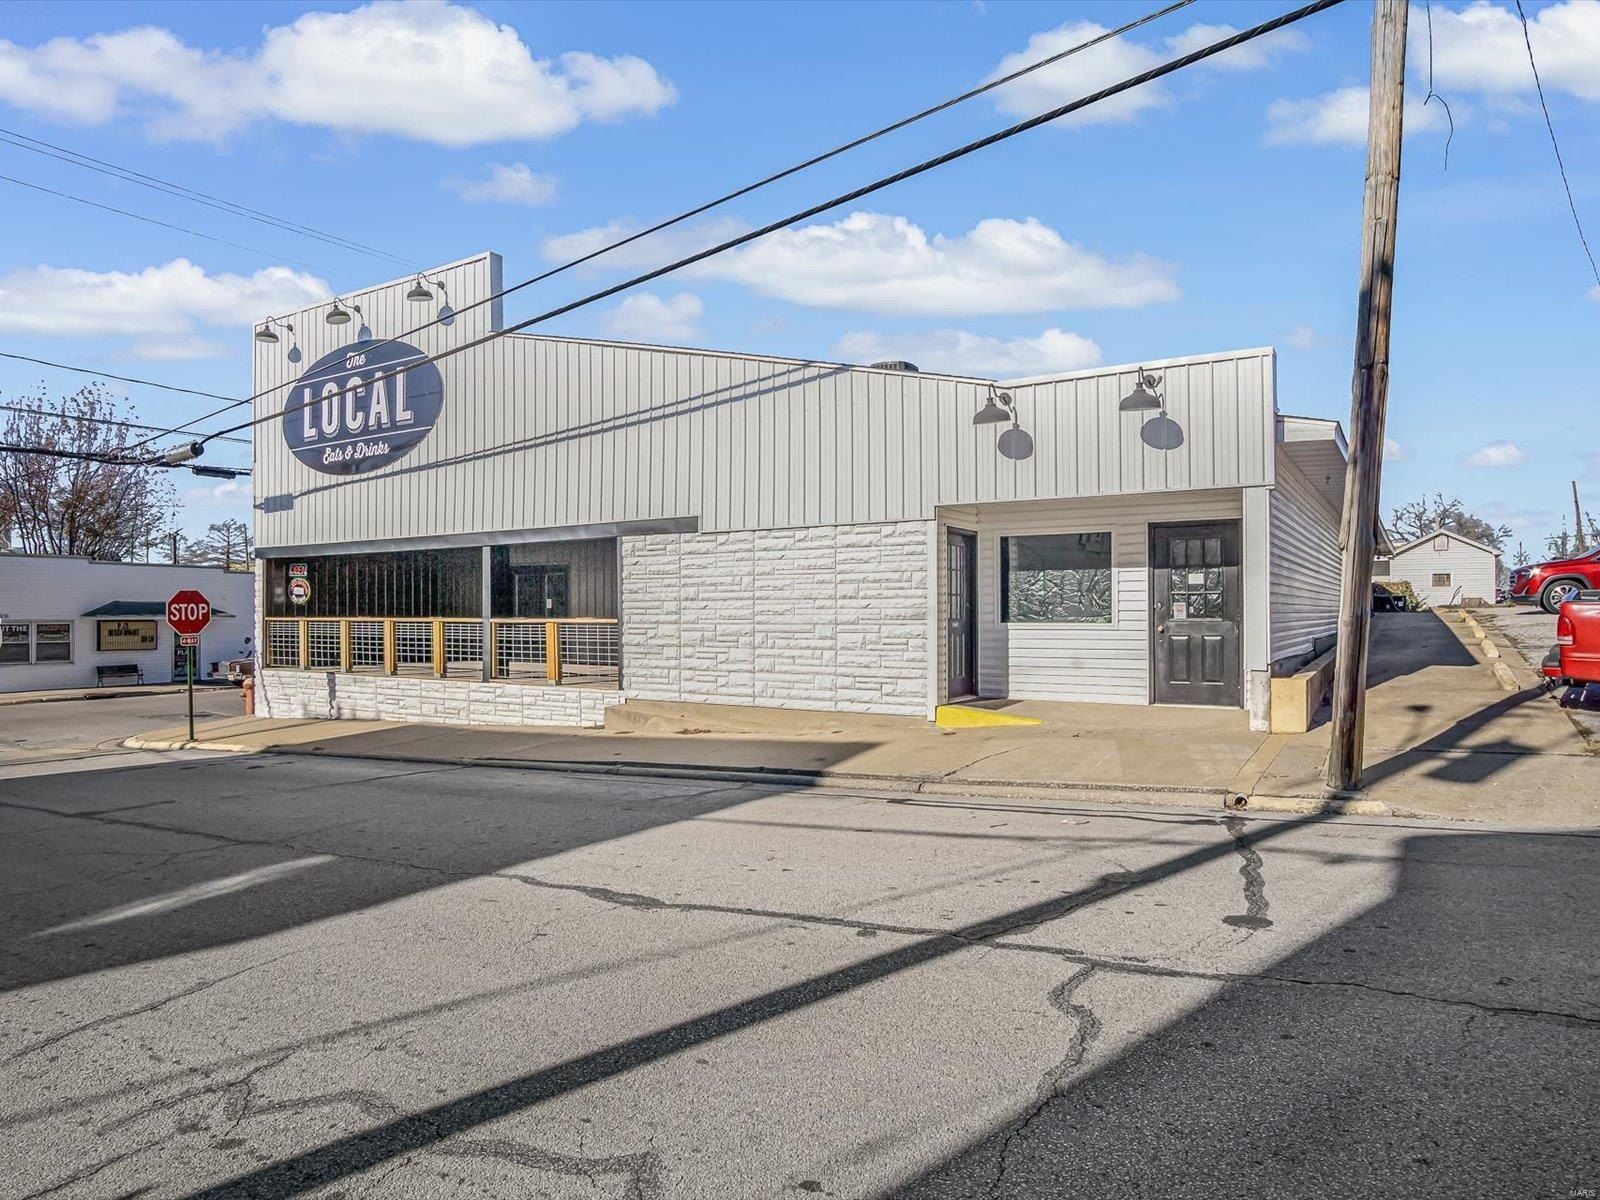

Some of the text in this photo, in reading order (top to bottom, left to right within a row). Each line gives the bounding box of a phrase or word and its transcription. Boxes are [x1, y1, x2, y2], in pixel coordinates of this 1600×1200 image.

[346, 352, 365, 368] The
[303, 366, 414, 442] LOCAL
[323, 441, 390, 464] Eats & Drinks
[170, 603, 208, 621] STOP
